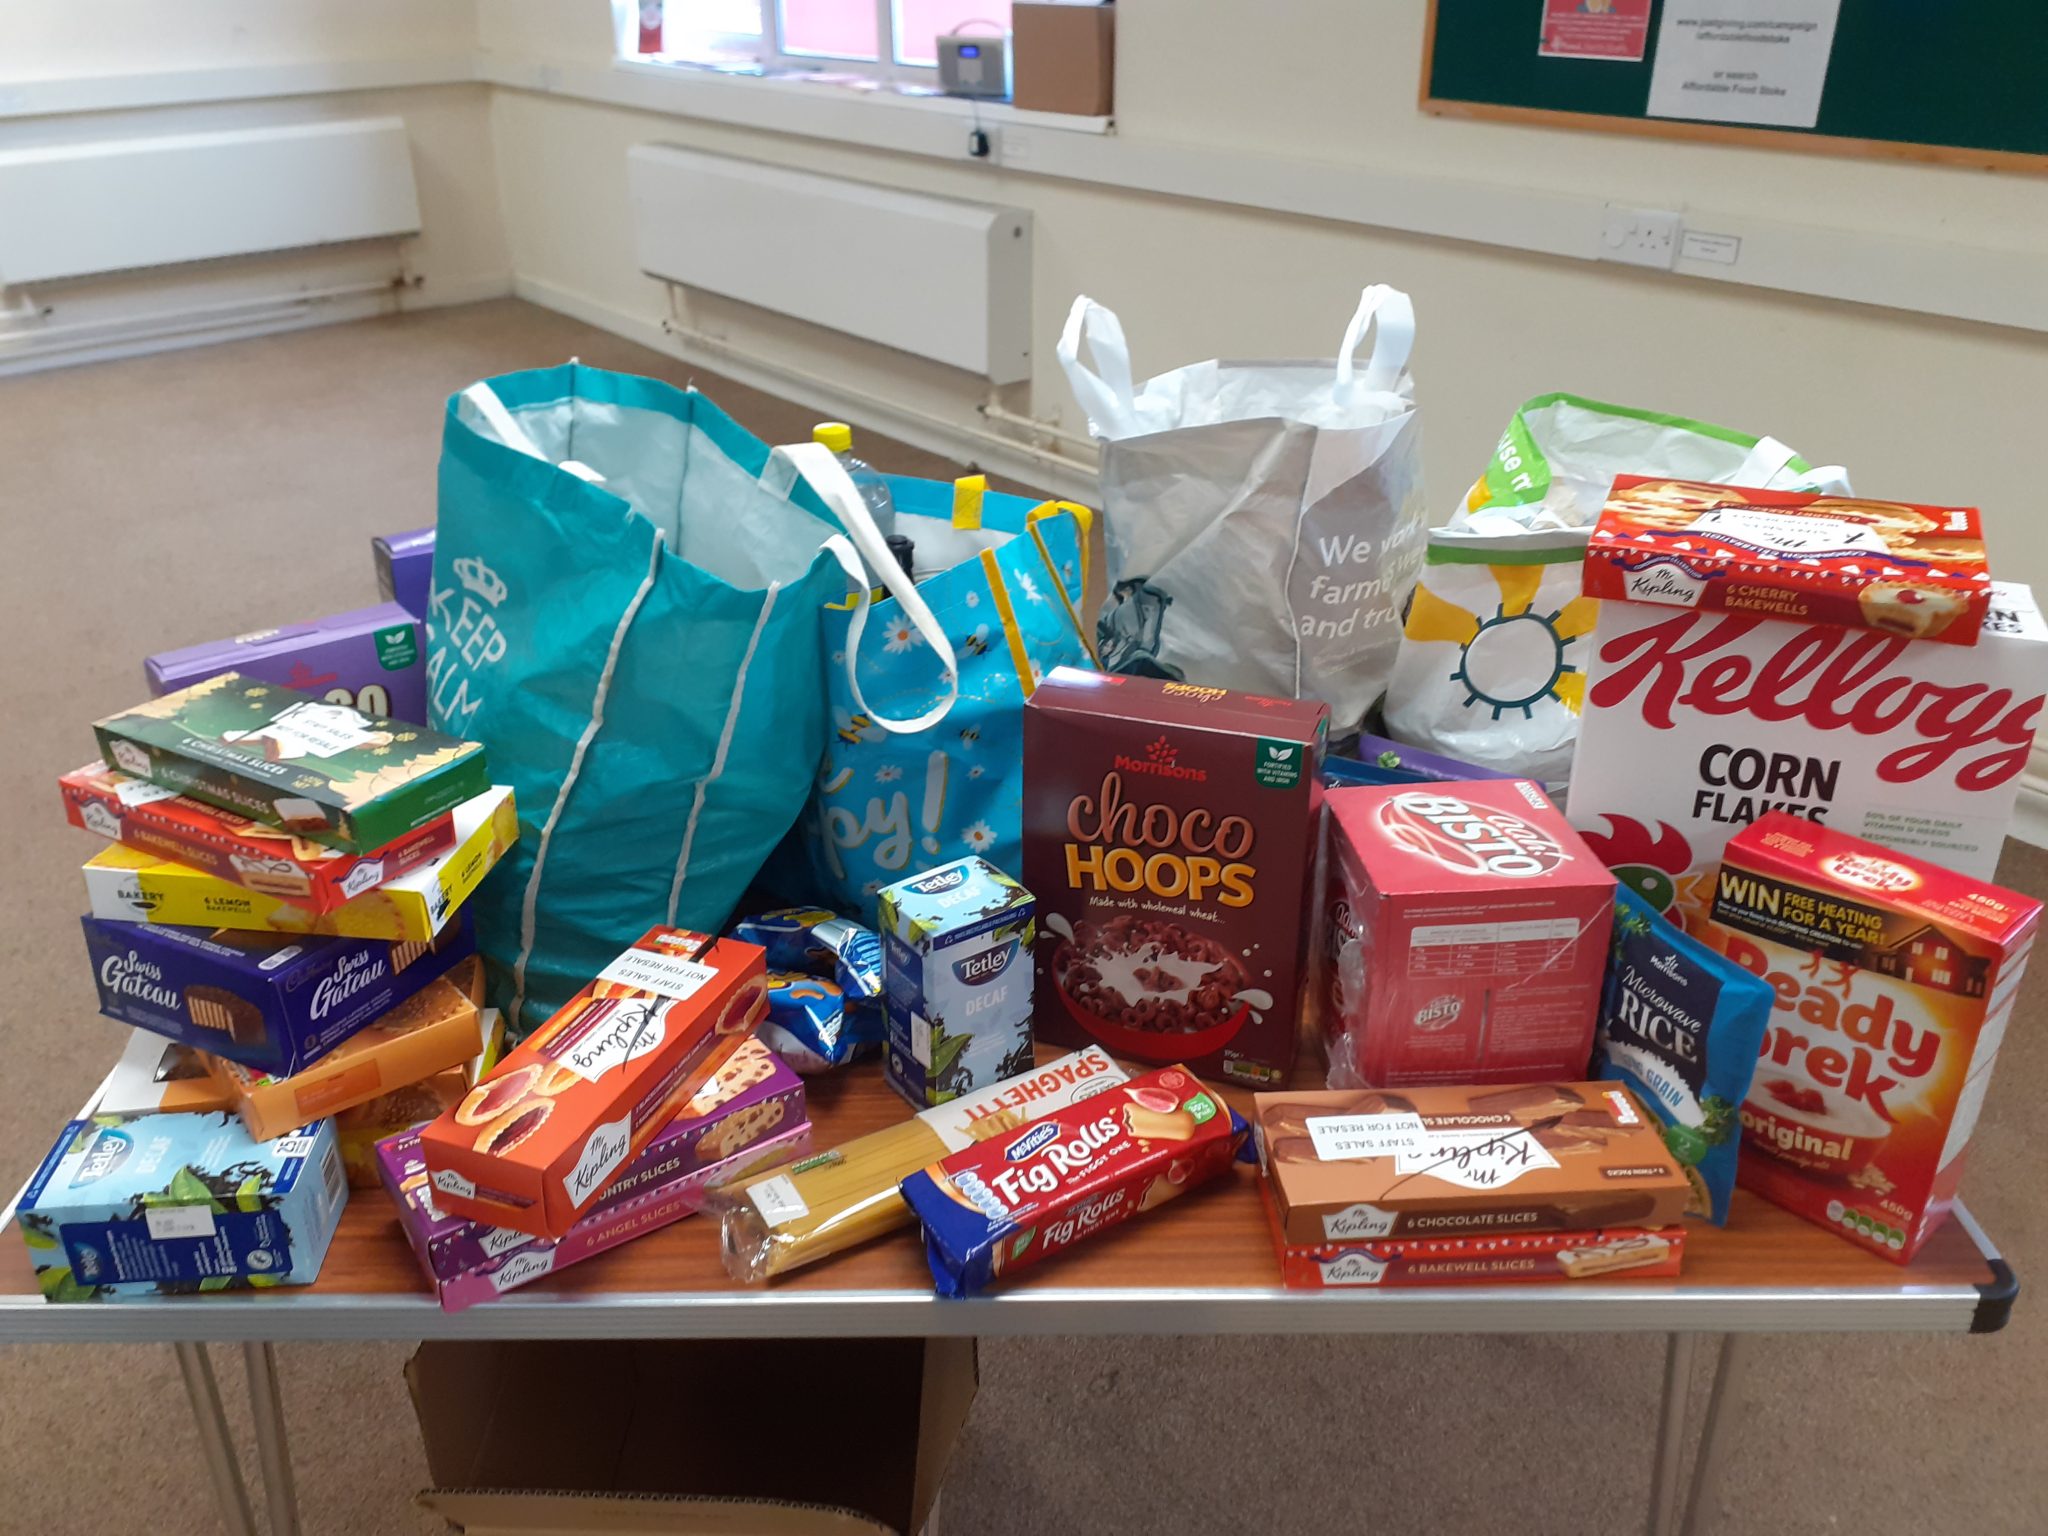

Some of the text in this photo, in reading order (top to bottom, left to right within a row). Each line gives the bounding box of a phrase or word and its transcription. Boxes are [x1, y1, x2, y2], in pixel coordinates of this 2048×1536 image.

[1320, 534, 1371, 567] We
[1656, 568, 1672, 580] Mr
[1631, 577, 1695, 602] Kipling
[1726, 585, 1799, 602] 6 CHERRY
[1725, 596, 1809, 616] BAKEWELLS
[431, 577, 507, 671] KEEP
[1301, 607, 1397, 639] and tru
[426, 623, 483, 738] ALM
[192, 737, 248, 763] CHRISTMAS
[248, 758, 289, 775] SLICES
[1114, 754, 1207, 782] Morrisons
[1700, 744, 1841, 802] CORN
[232, 791, 270, 814] SLICES
[1067, 771, 1254, 859] choco
[139, 831, 186, 855] BAKEWELL
[186, 847, 218, 866] SLICES
[1401, 797, 1543, 876] BISTO
[912, 869, 963, 893] Tetley
[1064, 843, 1257, 908] HOOPS
[117, 889, 164, 901] BAKERY
[204, 896, 252, 907] 6 LEMON
[1089, 896, 1115, 907] Made
[1117, 898, 1138, 909] with
[1141, 899, 1187, 916] wholemeal
[1721, 871, 1782, 916] WIN
[1782, 906, 1816, 927] FOR
[1819, 918, 1831, 932] A
[1836, 920, 1888, 946] YEAR!
[1784, 892, 1816, 912] FREE
[1818, 901, 1883, 930] HEATING
[123, 950, 162, 980] Swiss
[333, 949, 370, 984] Swiss
[624, 954, 708, 981] NOT FOR RESALE
[960, 946, 1012, 980] Tetley
[1650, 954, 1689, 987] Morrisons
[101, 954, 183, 1011] Gateau
[309, 959, 388, 1021] Gateau
[618, 968, 685, 991] STAFF SALES
[966, 986, 1008, 1017] DECAF
[1418, 1001, 1460, 1021] BISTO
[1621, 964, 1702, 1033] Microwave
[572, 1003, 658, 1068] Kipling
[1619, 986, 1698, 1063] RICE
[634, 1031, 657, 1051] Mr
[963, 1053, 1110, 1122] SPAGHETTI
[1646, 1068, 1684, 1108] GRAIN
[1317, 1123, 1365, 1135] RESALE
[1368, 1122, 1392, 1132] FOR
[1395, 1121, 1419, 1131] NOT
[1437, 1115, 1504, 1125] CHOCOLATE
[1505, 1114, 1511, 1122] 6
[590, 1135, 605, 1157] Mr
[1041, 1117, 1120, 1176] Rolls
[1108, 1141, 1132, 1156] ONE
[1335, 1138, 1415, 1150] STAFF SALES
[1740, 1110, 1854, 1161] original
[79, 1135, 126, 1183] Tetley
[573, 1133, 627, 1197] Kipling
[640, 1157, 681, 1182] SLICES
[437, 1176, 472, 1196] Kipling
[992, 1163, 1059, 1206] Fig
[1464, 1169, 1501, 1186] Mr
[1077, 1188, 1126, 1229] Rolls
[1407, 1211, 1539, 1229] 6 CHOCOLATE SLICES
[1879, 1199, 1913, 1222] 450g
[586, 1201, 681, 1247] 6 ANGEL SLICES
[1042, 1219, 1074, 1250] Fig
[1331, 1215, 1388, 1234] Kipling
[490, 1231, 524, 1251] Kipli
[499, 1257, 548, 1286] Kipling
[1327, 1263, 1380, 1281] Kipling
[1407, 1259, 1535, 1274] 6 BAKEWELL SLICES
